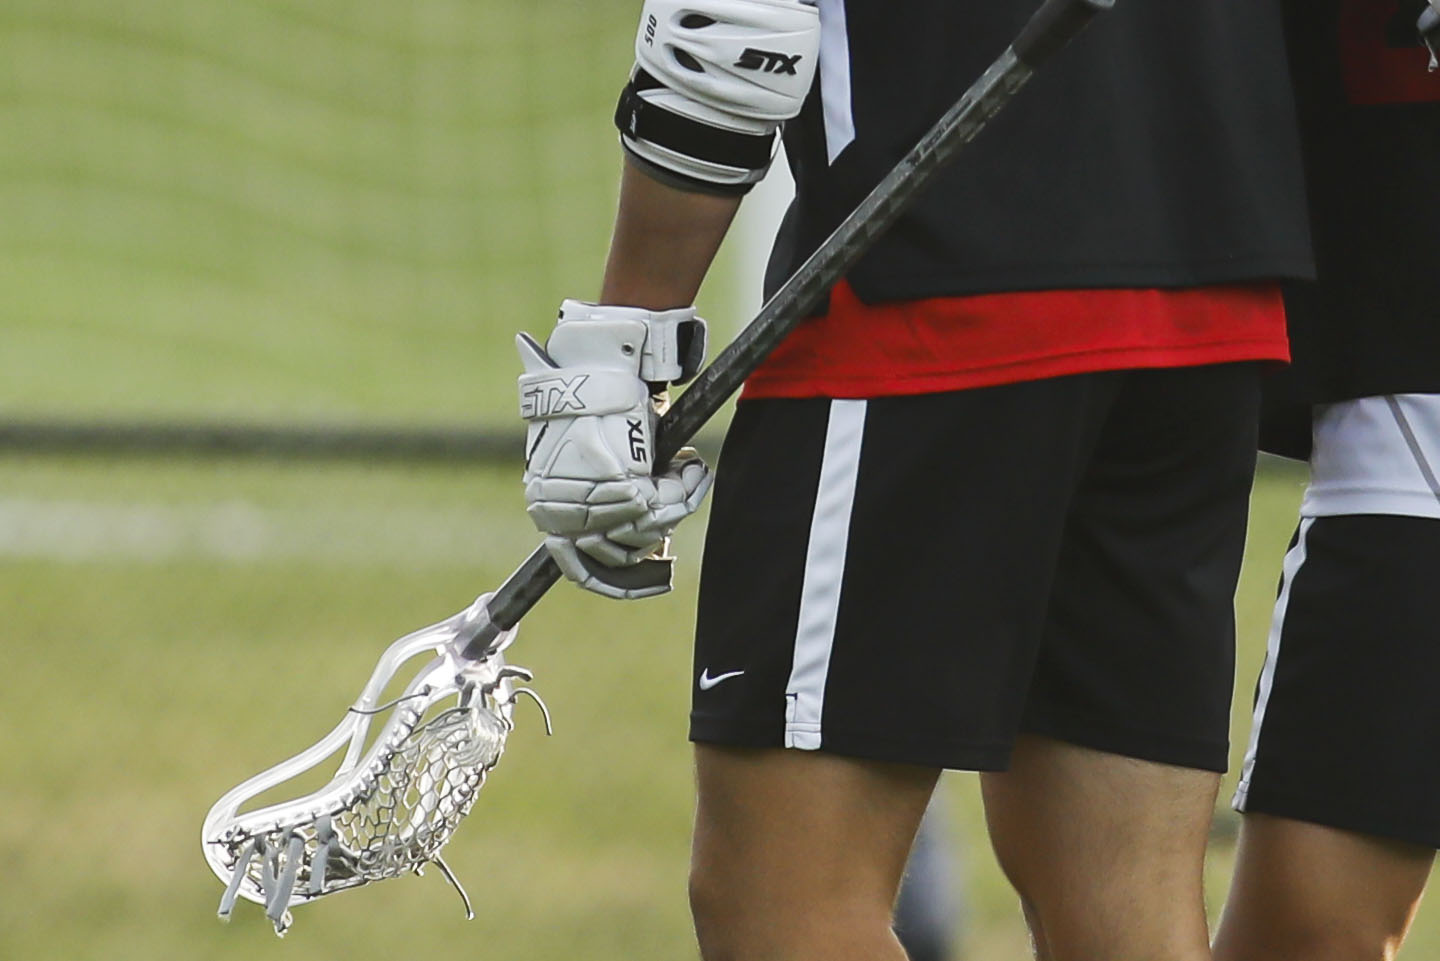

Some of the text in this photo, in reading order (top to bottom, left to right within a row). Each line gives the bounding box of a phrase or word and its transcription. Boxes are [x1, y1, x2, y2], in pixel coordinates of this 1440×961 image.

[645, 14, 658, 48] 500
[733, 48, 802, 75] STX
[521, 374, 590, 419] STX
[626, 419, 648, 464] STX
